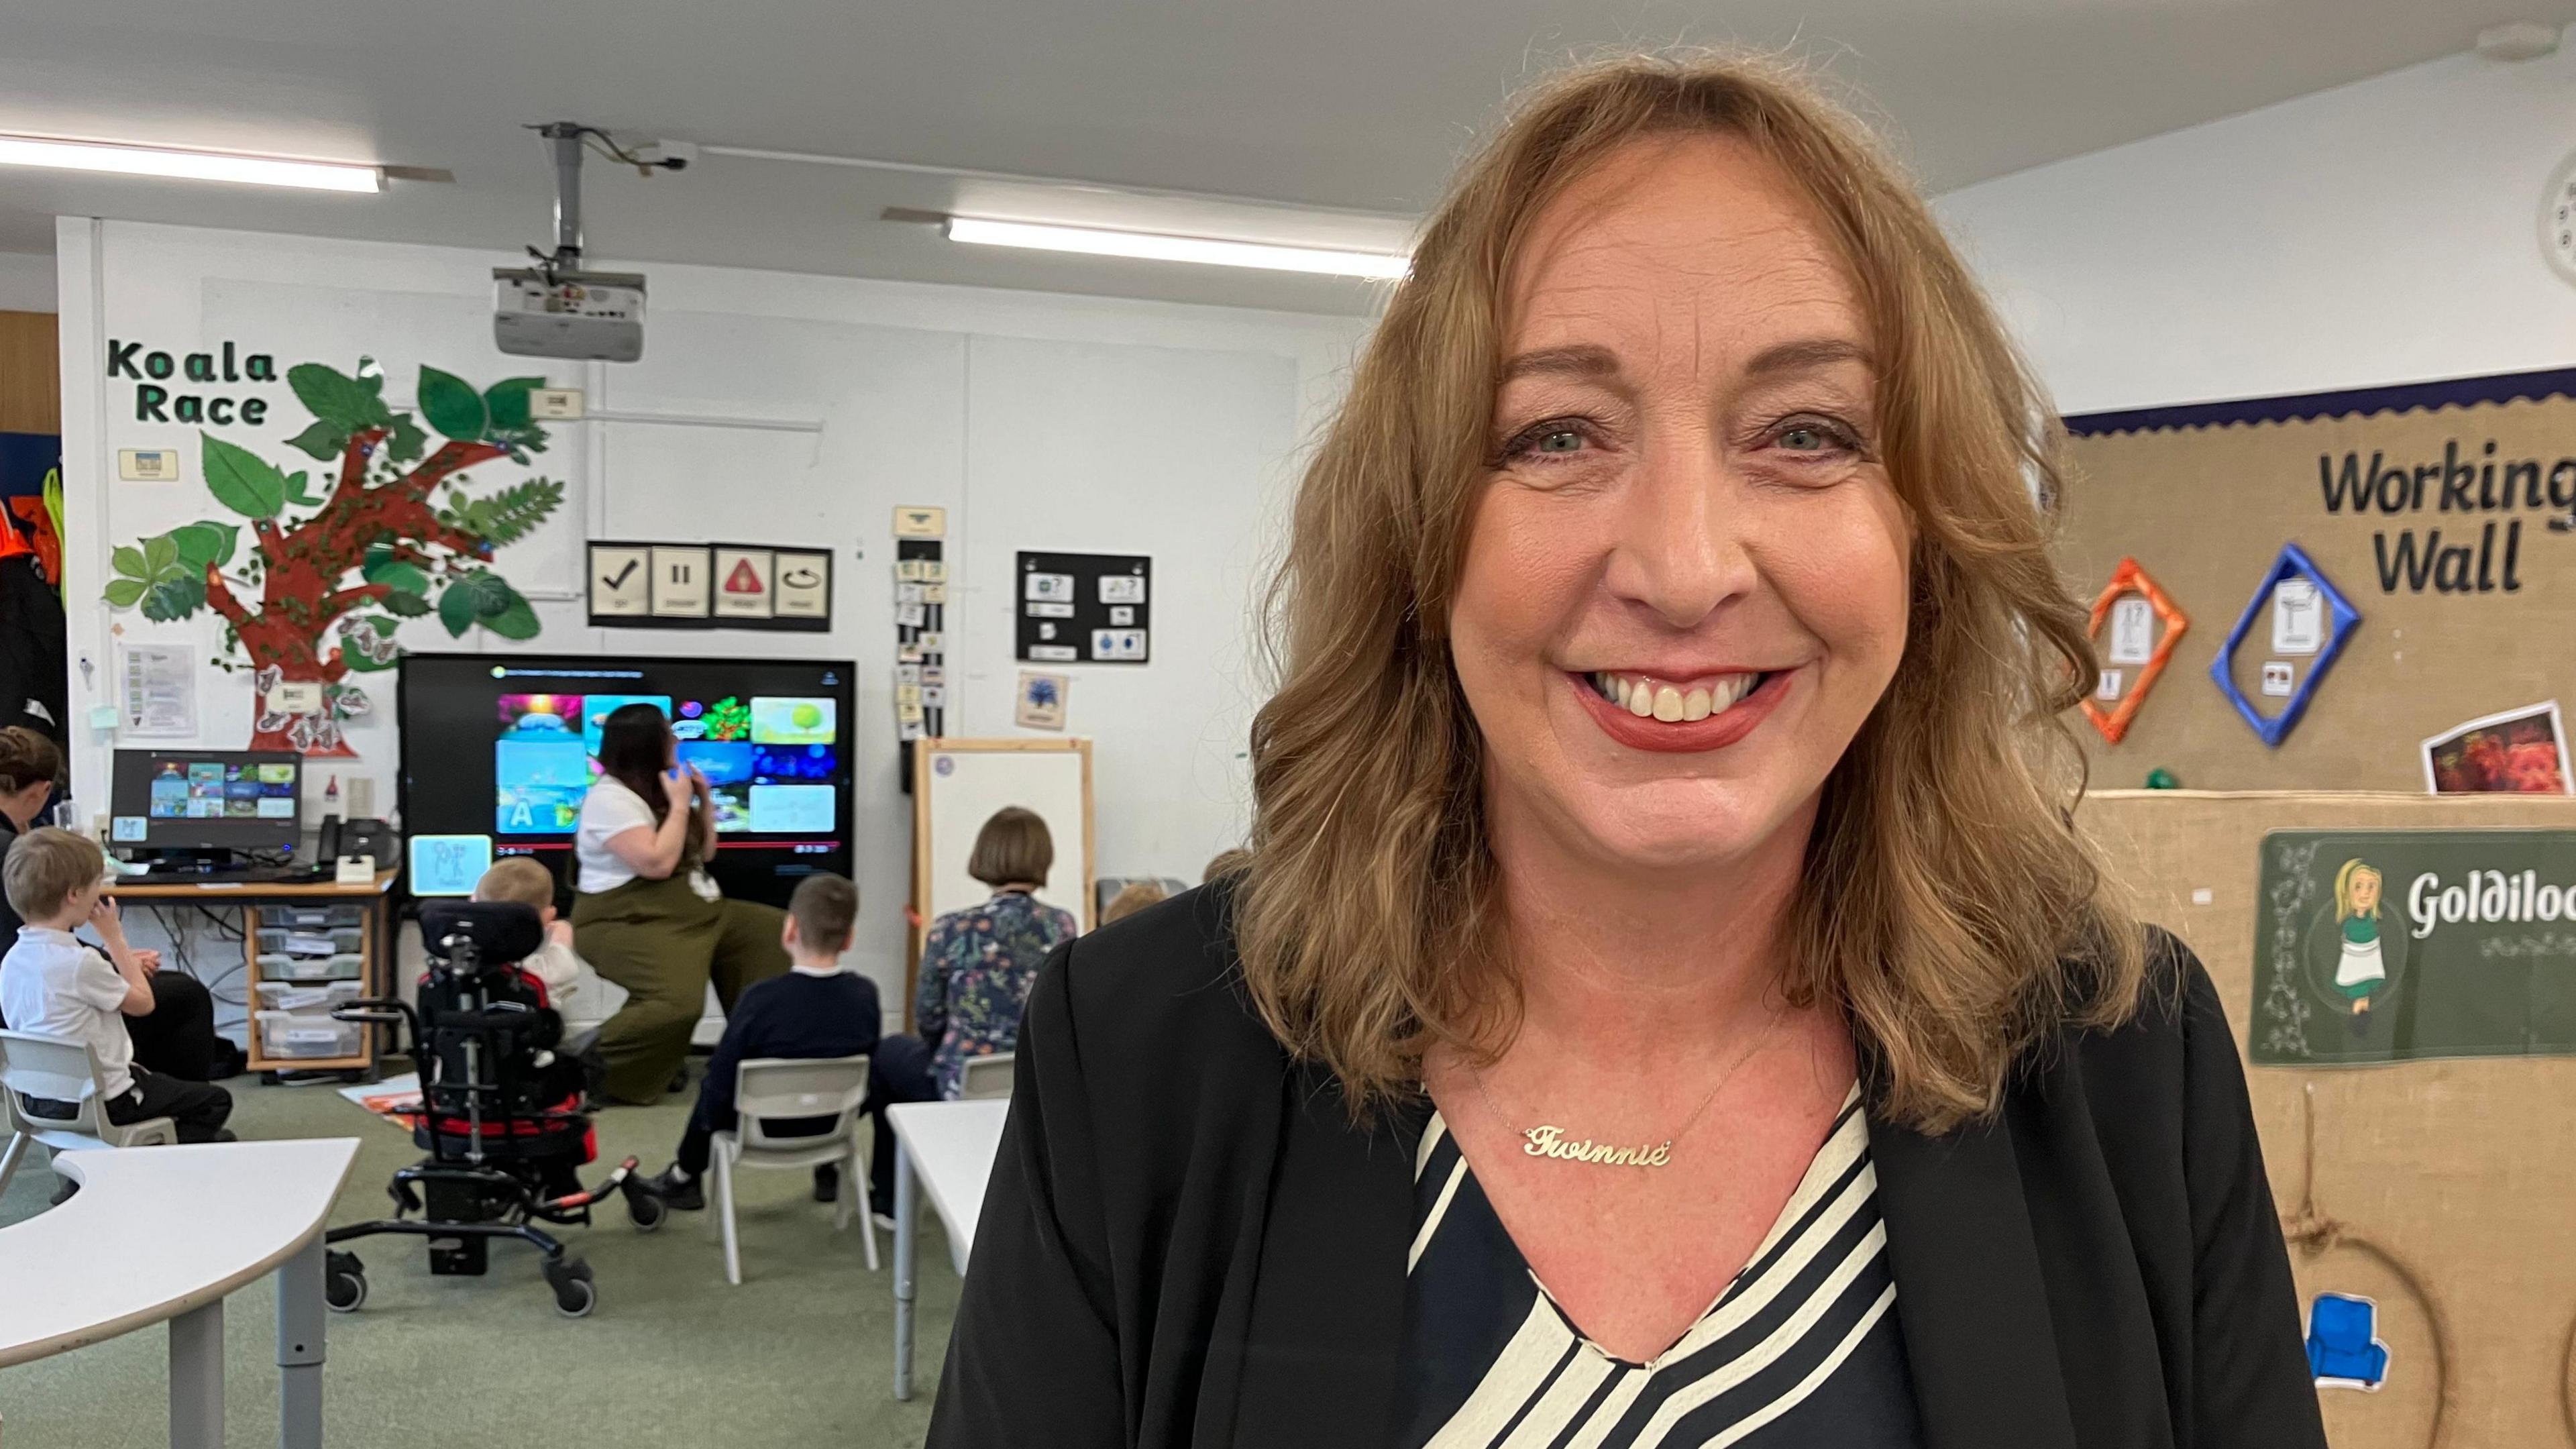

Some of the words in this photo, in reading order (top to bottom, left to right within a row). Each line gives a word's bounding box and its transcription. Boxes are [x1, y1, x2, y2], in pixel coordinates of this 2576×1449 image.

[107, 338, 278, 383] Koala
[136, 383, 268, 426] Race
[2319, 439, 2576, 533] Working
[2373, 519, 2522, 594] Wall
[1523, 1125, 1671, 1167] Twinnie
